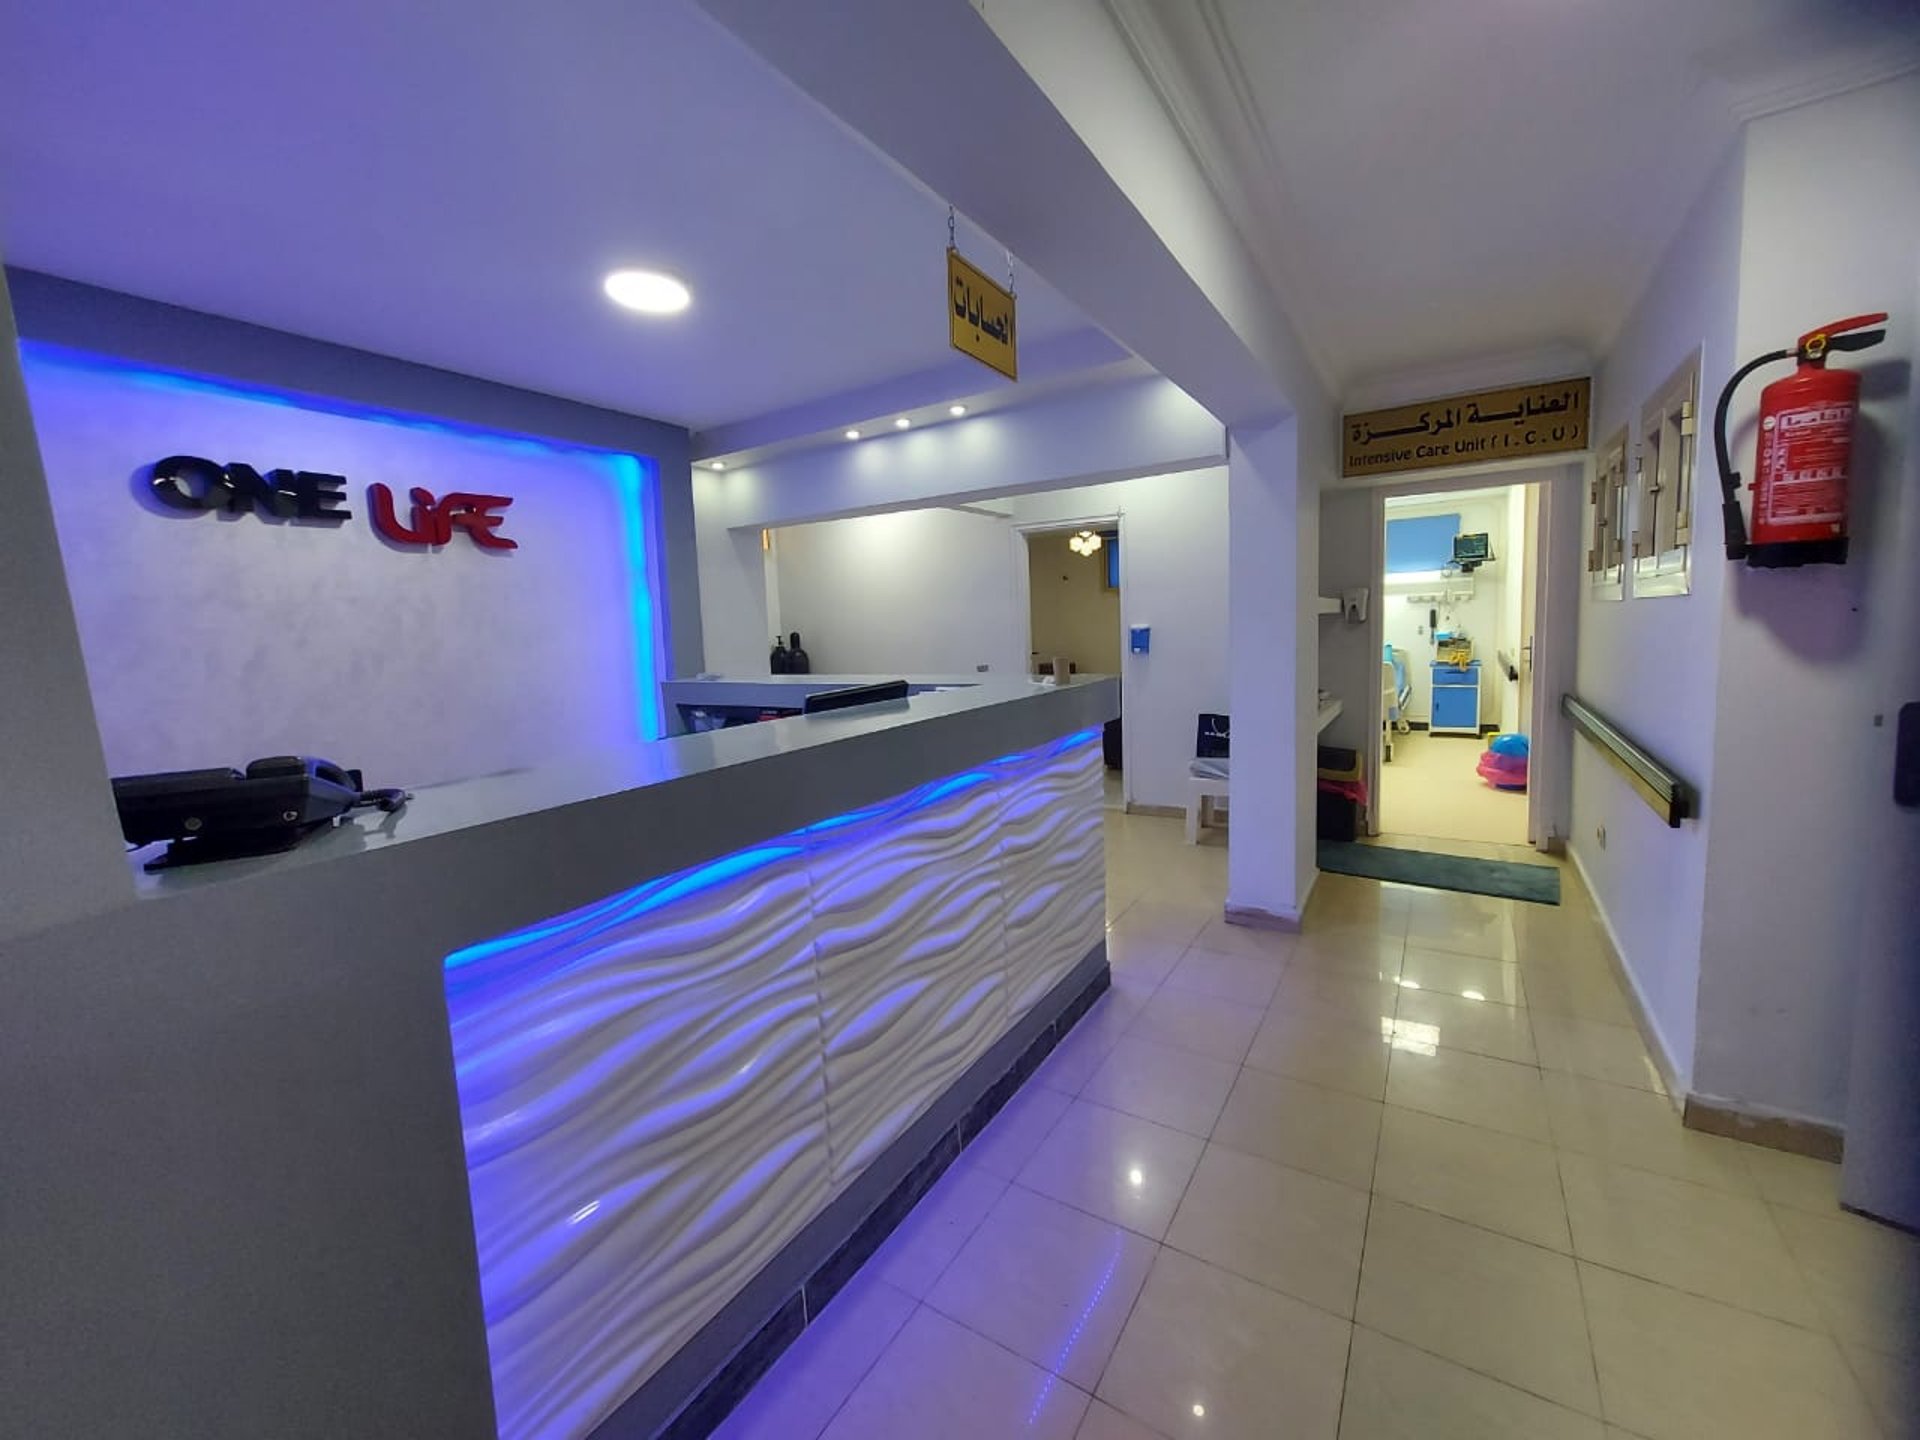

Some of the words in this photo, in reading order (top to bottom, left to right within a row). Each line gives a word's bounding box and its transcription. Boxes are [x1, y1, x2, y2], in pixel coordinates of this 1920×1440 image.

[953, 275, 1014, 350] الحسابات
[1351, 405, 1462, 446] المركزة
[1467, 390, 1580, 427] العناية
[1349, 448, 1412, 467] Intensive
[1416, 444, 1450, 459] Care
[1454, 439, 1486, 454] Unit
[150, 455, 353, 522] ONE
